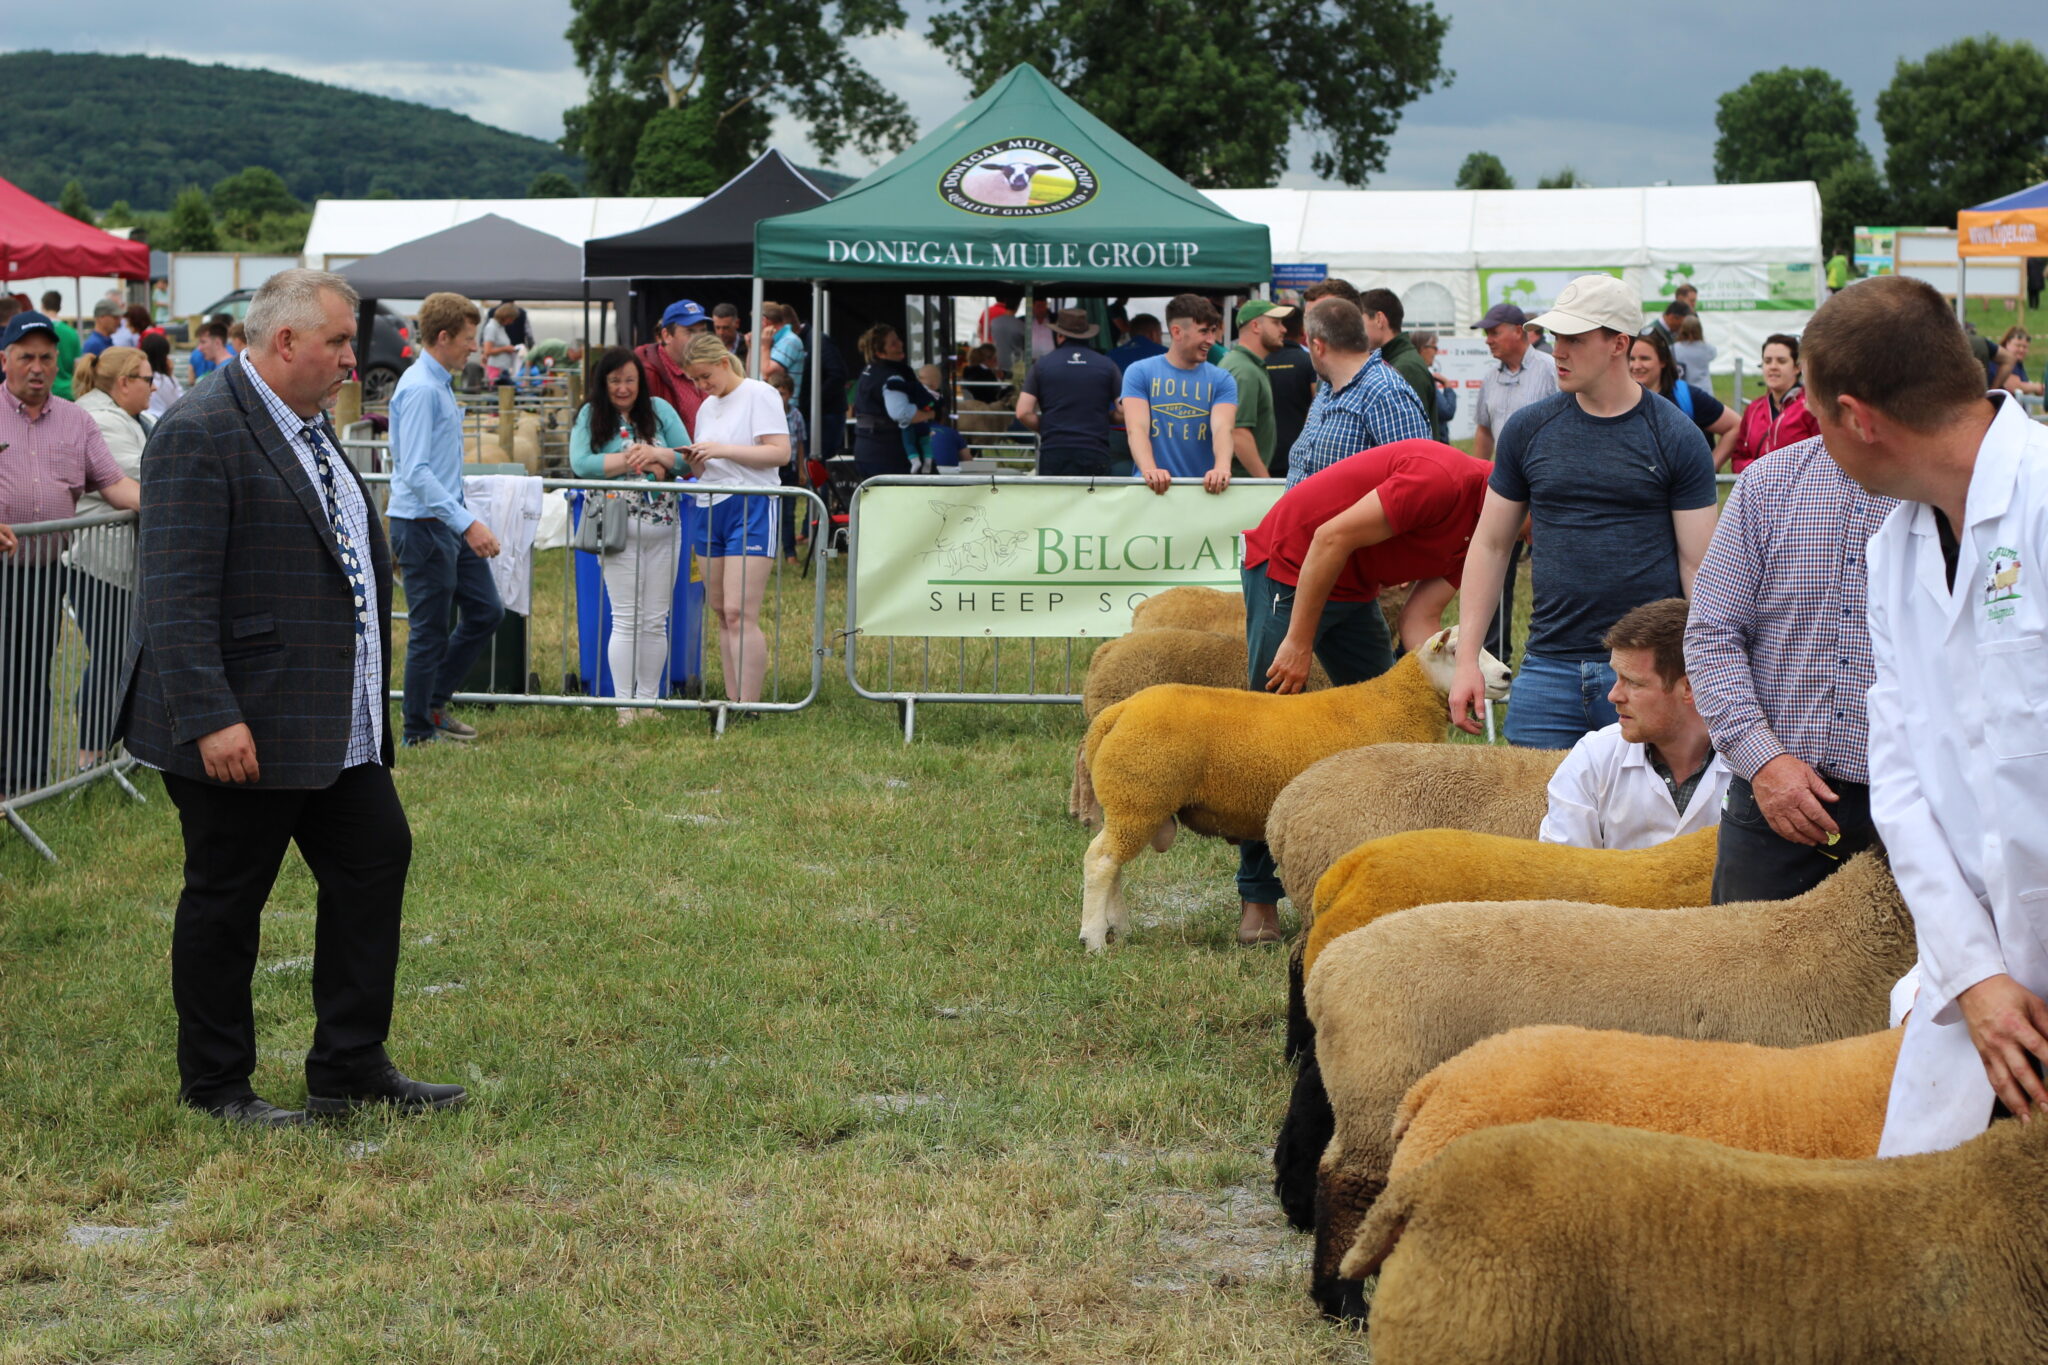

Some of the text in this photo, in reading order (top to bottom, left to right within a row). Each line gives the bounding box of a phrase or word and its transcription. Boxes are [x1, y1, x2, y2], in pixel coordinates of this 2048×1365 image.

[943, 139, 1094, 189] DONEGAL MULE GROUP
[948, 193, 1087, 216] QUALITY GUARANTEED
[827, 239, 1199, 268] DONEGAL MULE GROUP
[1151, 377, 1212, 402] HOLLI
[1151, 419, 1207, 441] STER
[929, 591, 1064, 612] SHEEP
